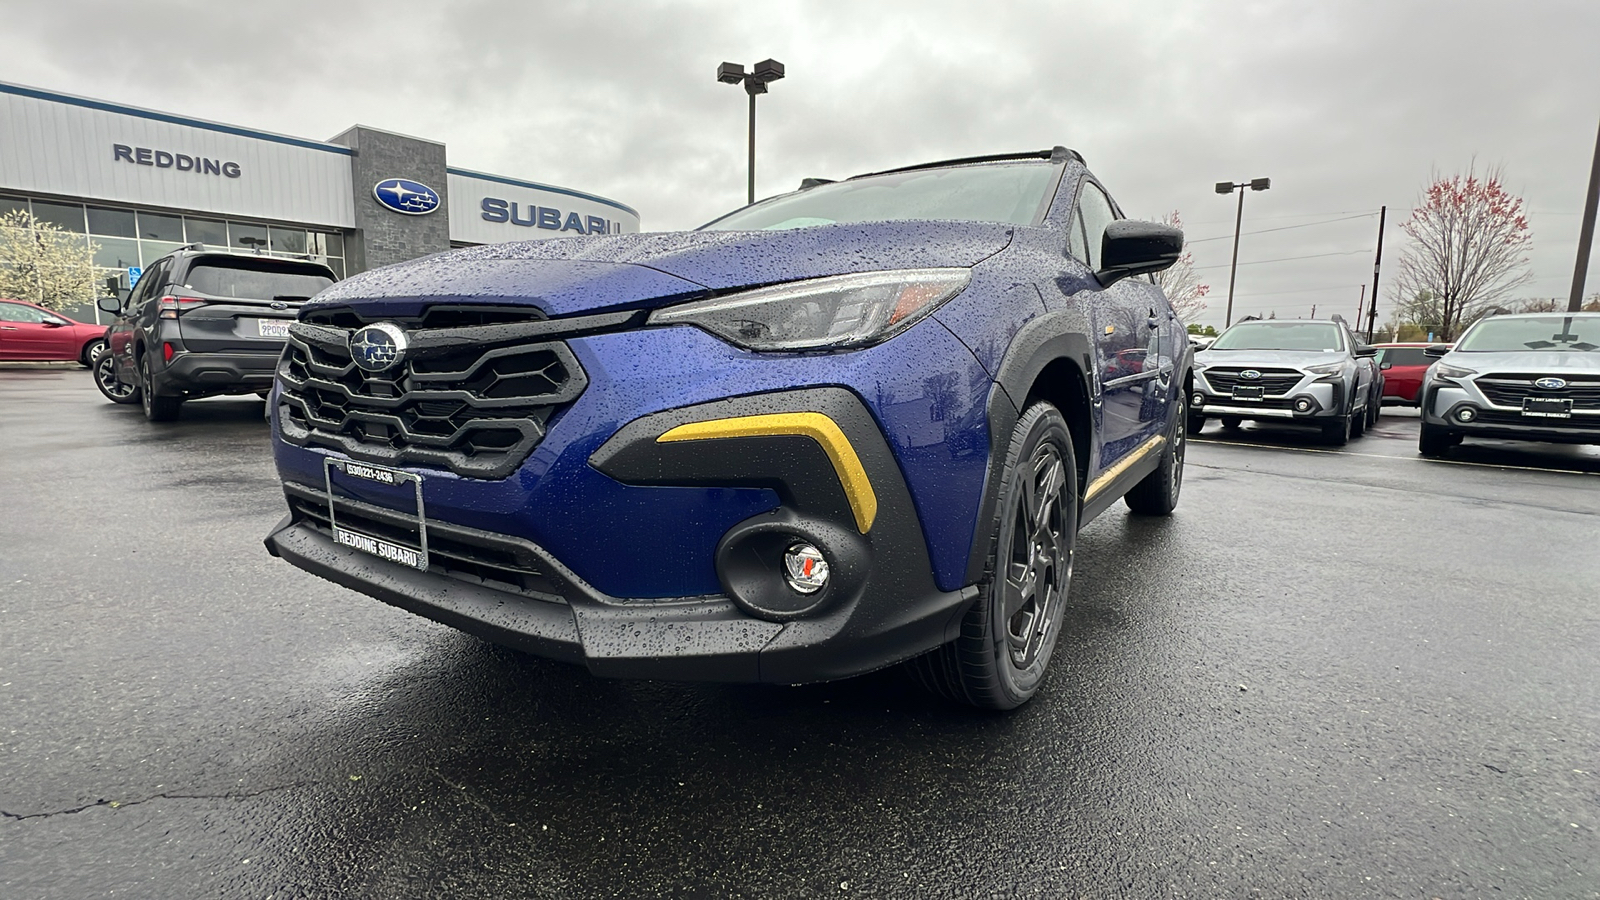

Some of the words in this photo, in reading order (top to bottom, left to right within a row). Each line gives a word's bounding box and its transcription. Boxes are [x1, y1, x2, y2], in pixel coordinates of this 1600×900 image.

[113, 143, 241, 178] REDDING
[481, 197, 621, 235] SUBARU
[346, 463, 394, 483] (530)221-2436
[338, 530, 377, 554] REDDING
[378, 541, 417, 566] SUBARU
